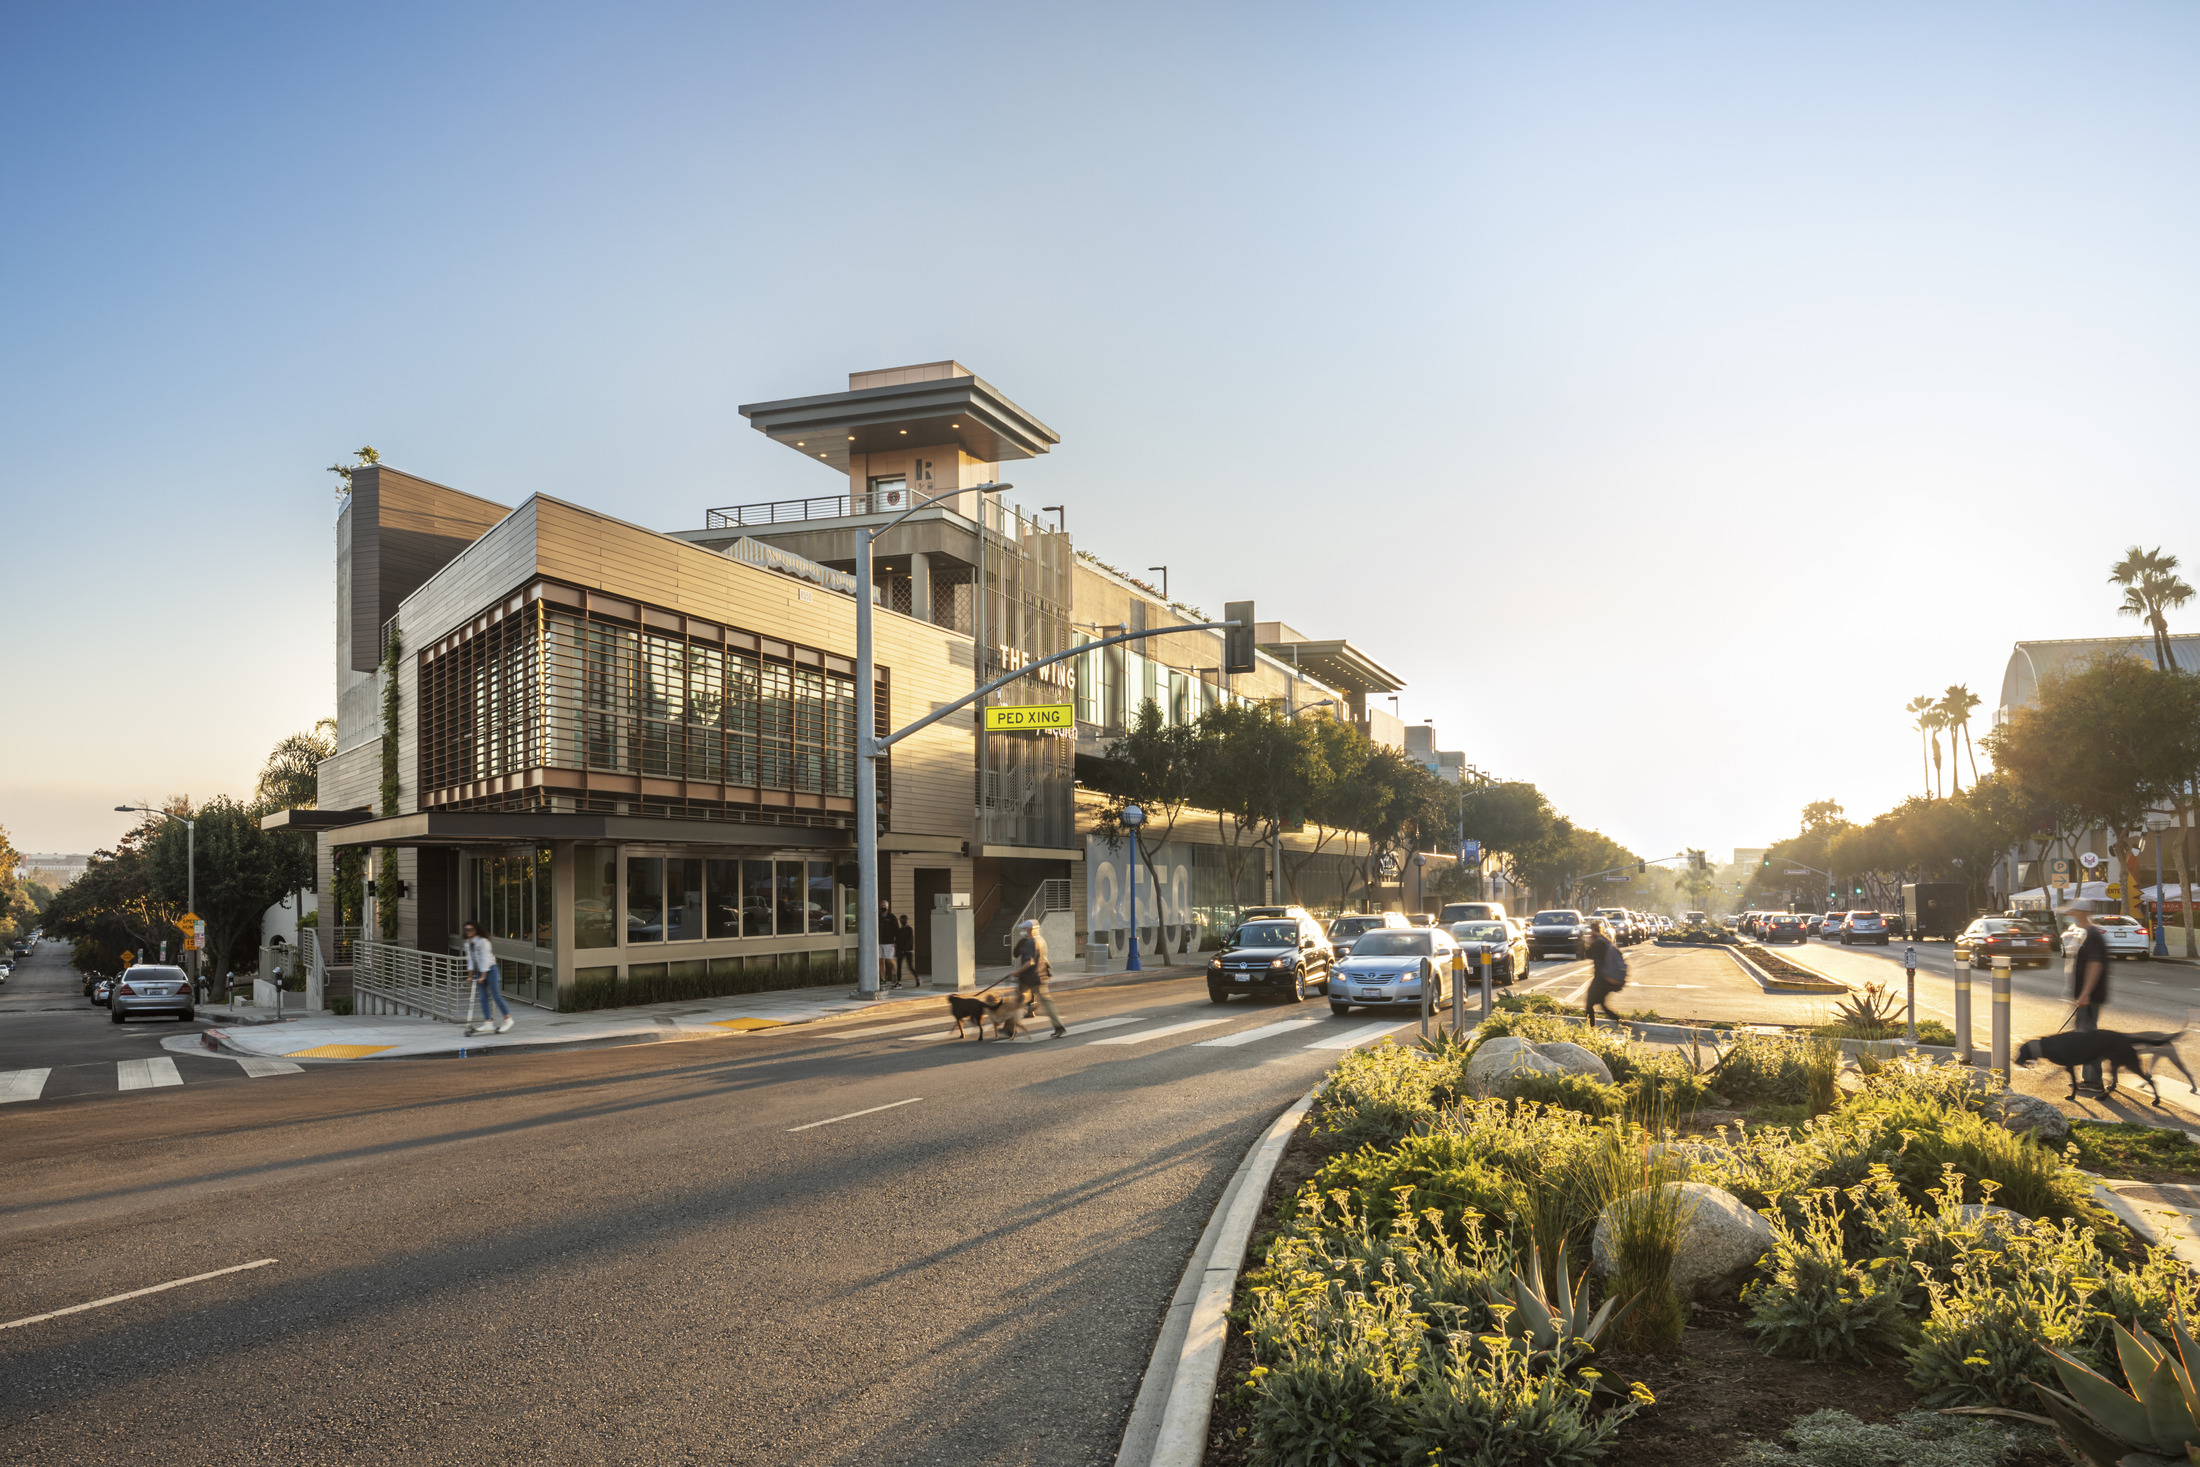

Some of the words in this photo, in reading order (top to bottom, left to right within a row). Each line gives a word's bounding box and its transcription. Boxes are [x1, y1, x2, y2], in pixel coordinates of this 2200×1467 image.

[1037, 656, 1075, 690] WING
[998, 712, 1023, 724] PED
[1028, 711, 1060, 723] XING
[2057, 862, 2064, 870] P
